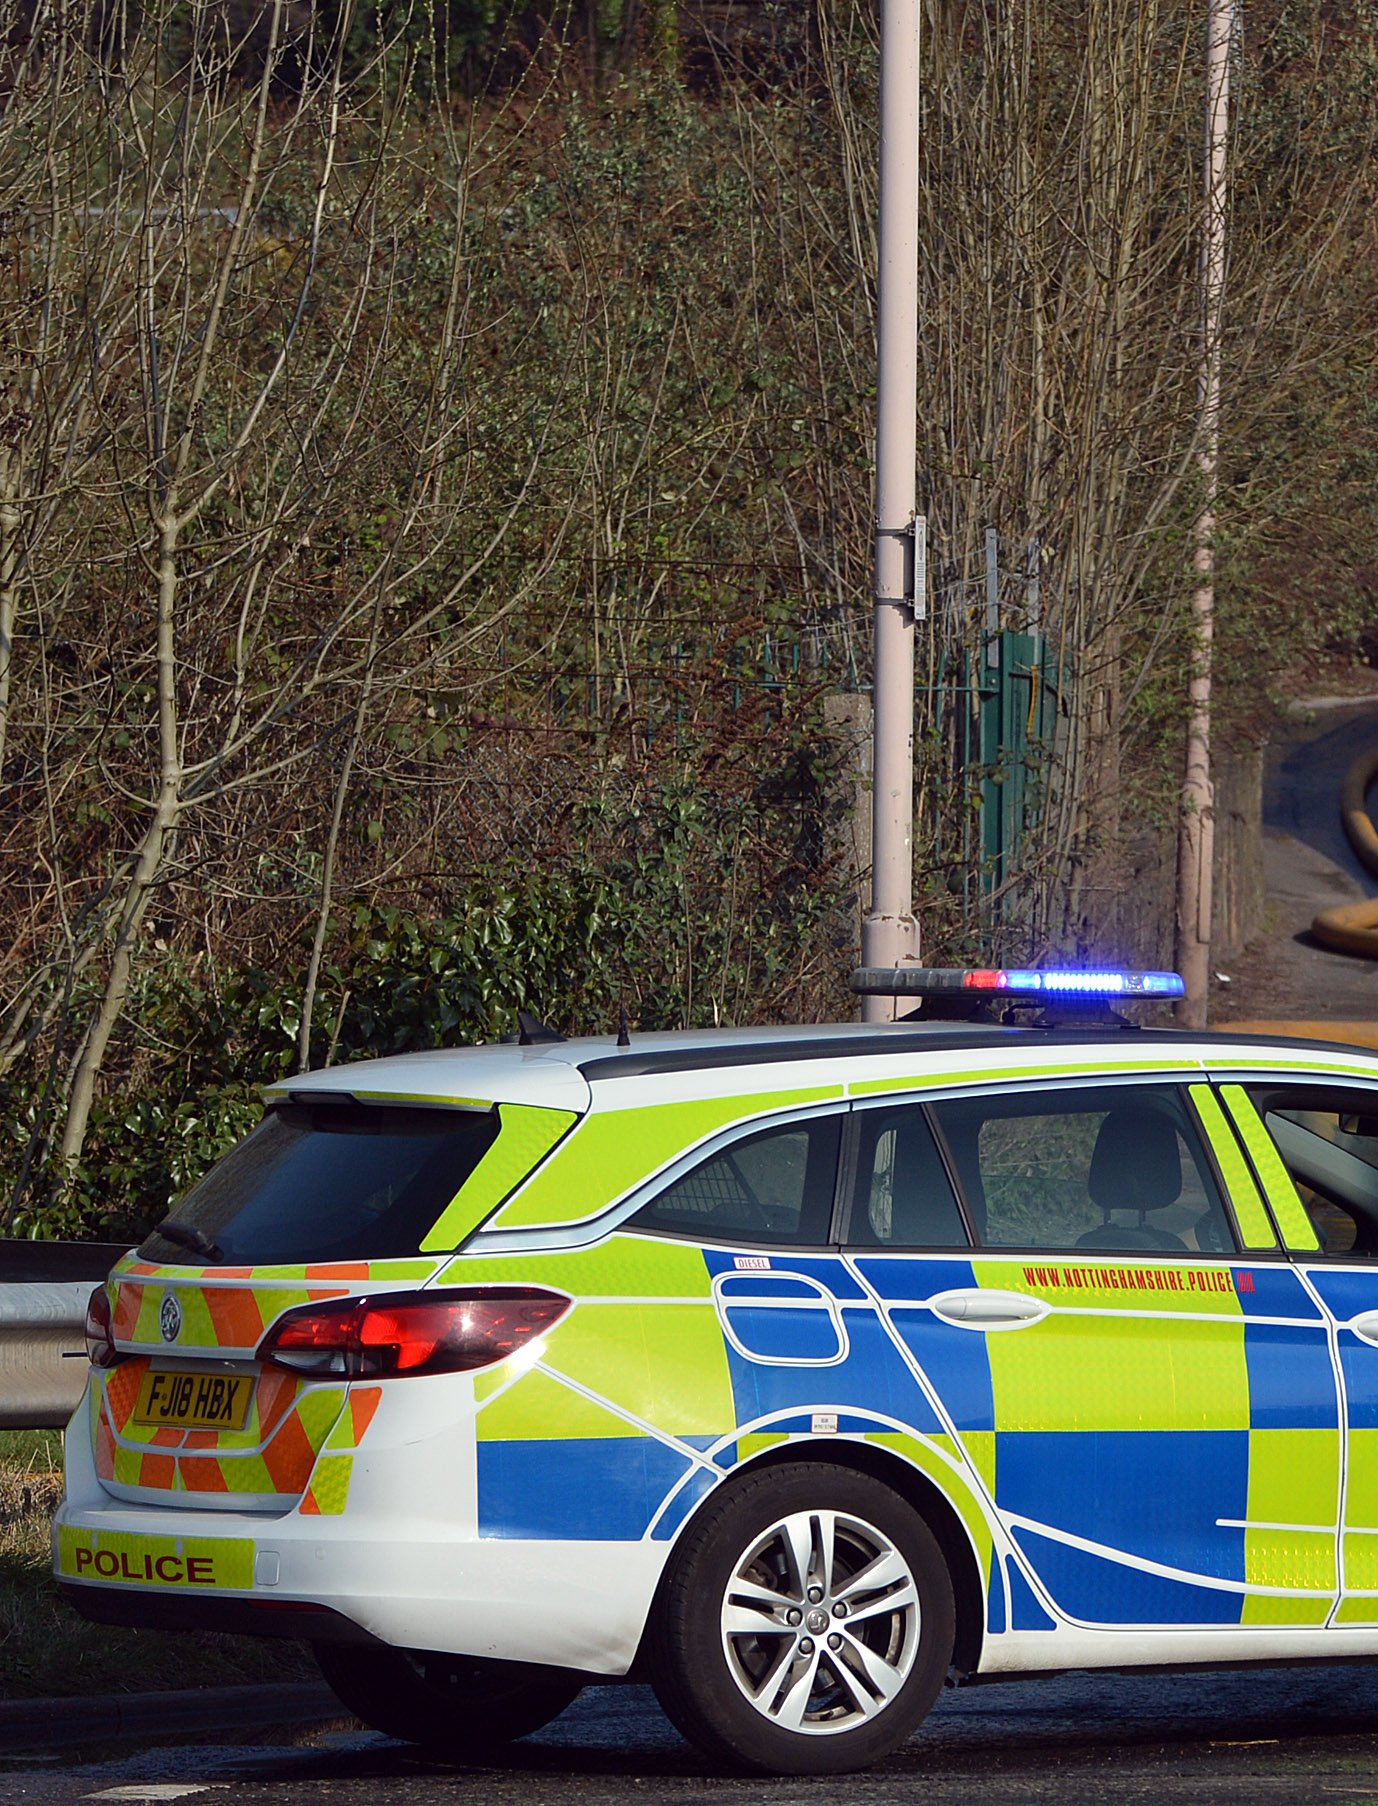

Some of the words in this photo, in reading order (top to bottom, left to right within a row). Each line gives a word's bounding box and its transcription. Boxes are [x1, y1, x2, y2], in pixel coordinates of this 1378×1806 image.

[738, 1258, 767, 1268] DIESEL
[146, 1375, 194, 1418] FJ18
[193, 1377, 240, 1421] HBX
[75, 1547, 217, 1584] POLICE
